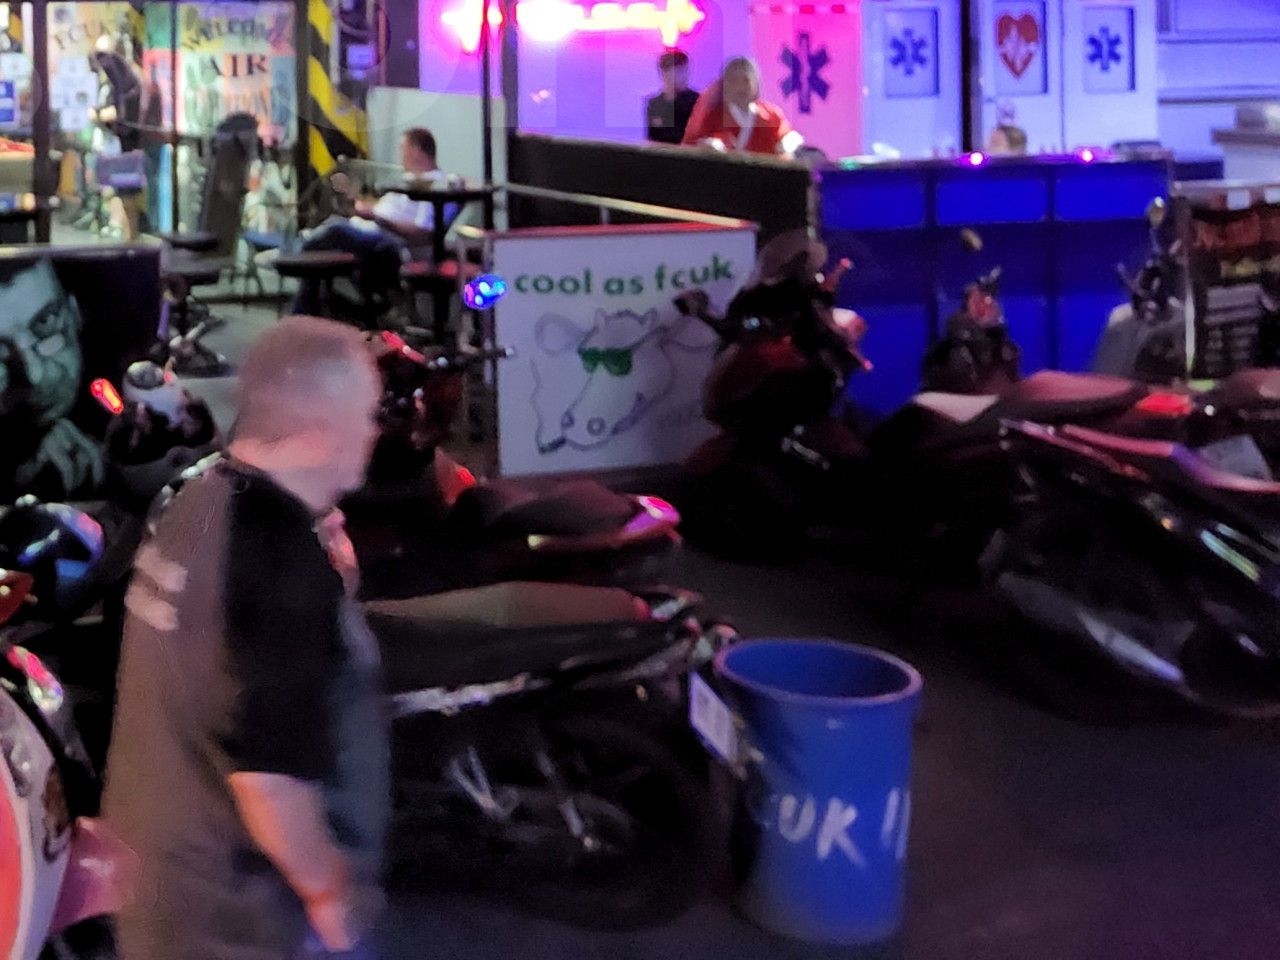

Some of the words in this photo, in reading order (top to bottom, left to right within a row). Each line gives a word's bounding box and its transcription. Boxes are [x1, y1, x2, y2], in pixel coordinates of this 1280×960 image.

[515, 267, 592, 294] cool
[604, 275, 644, 295] as
[654, 253, 734, 290] fcuk
